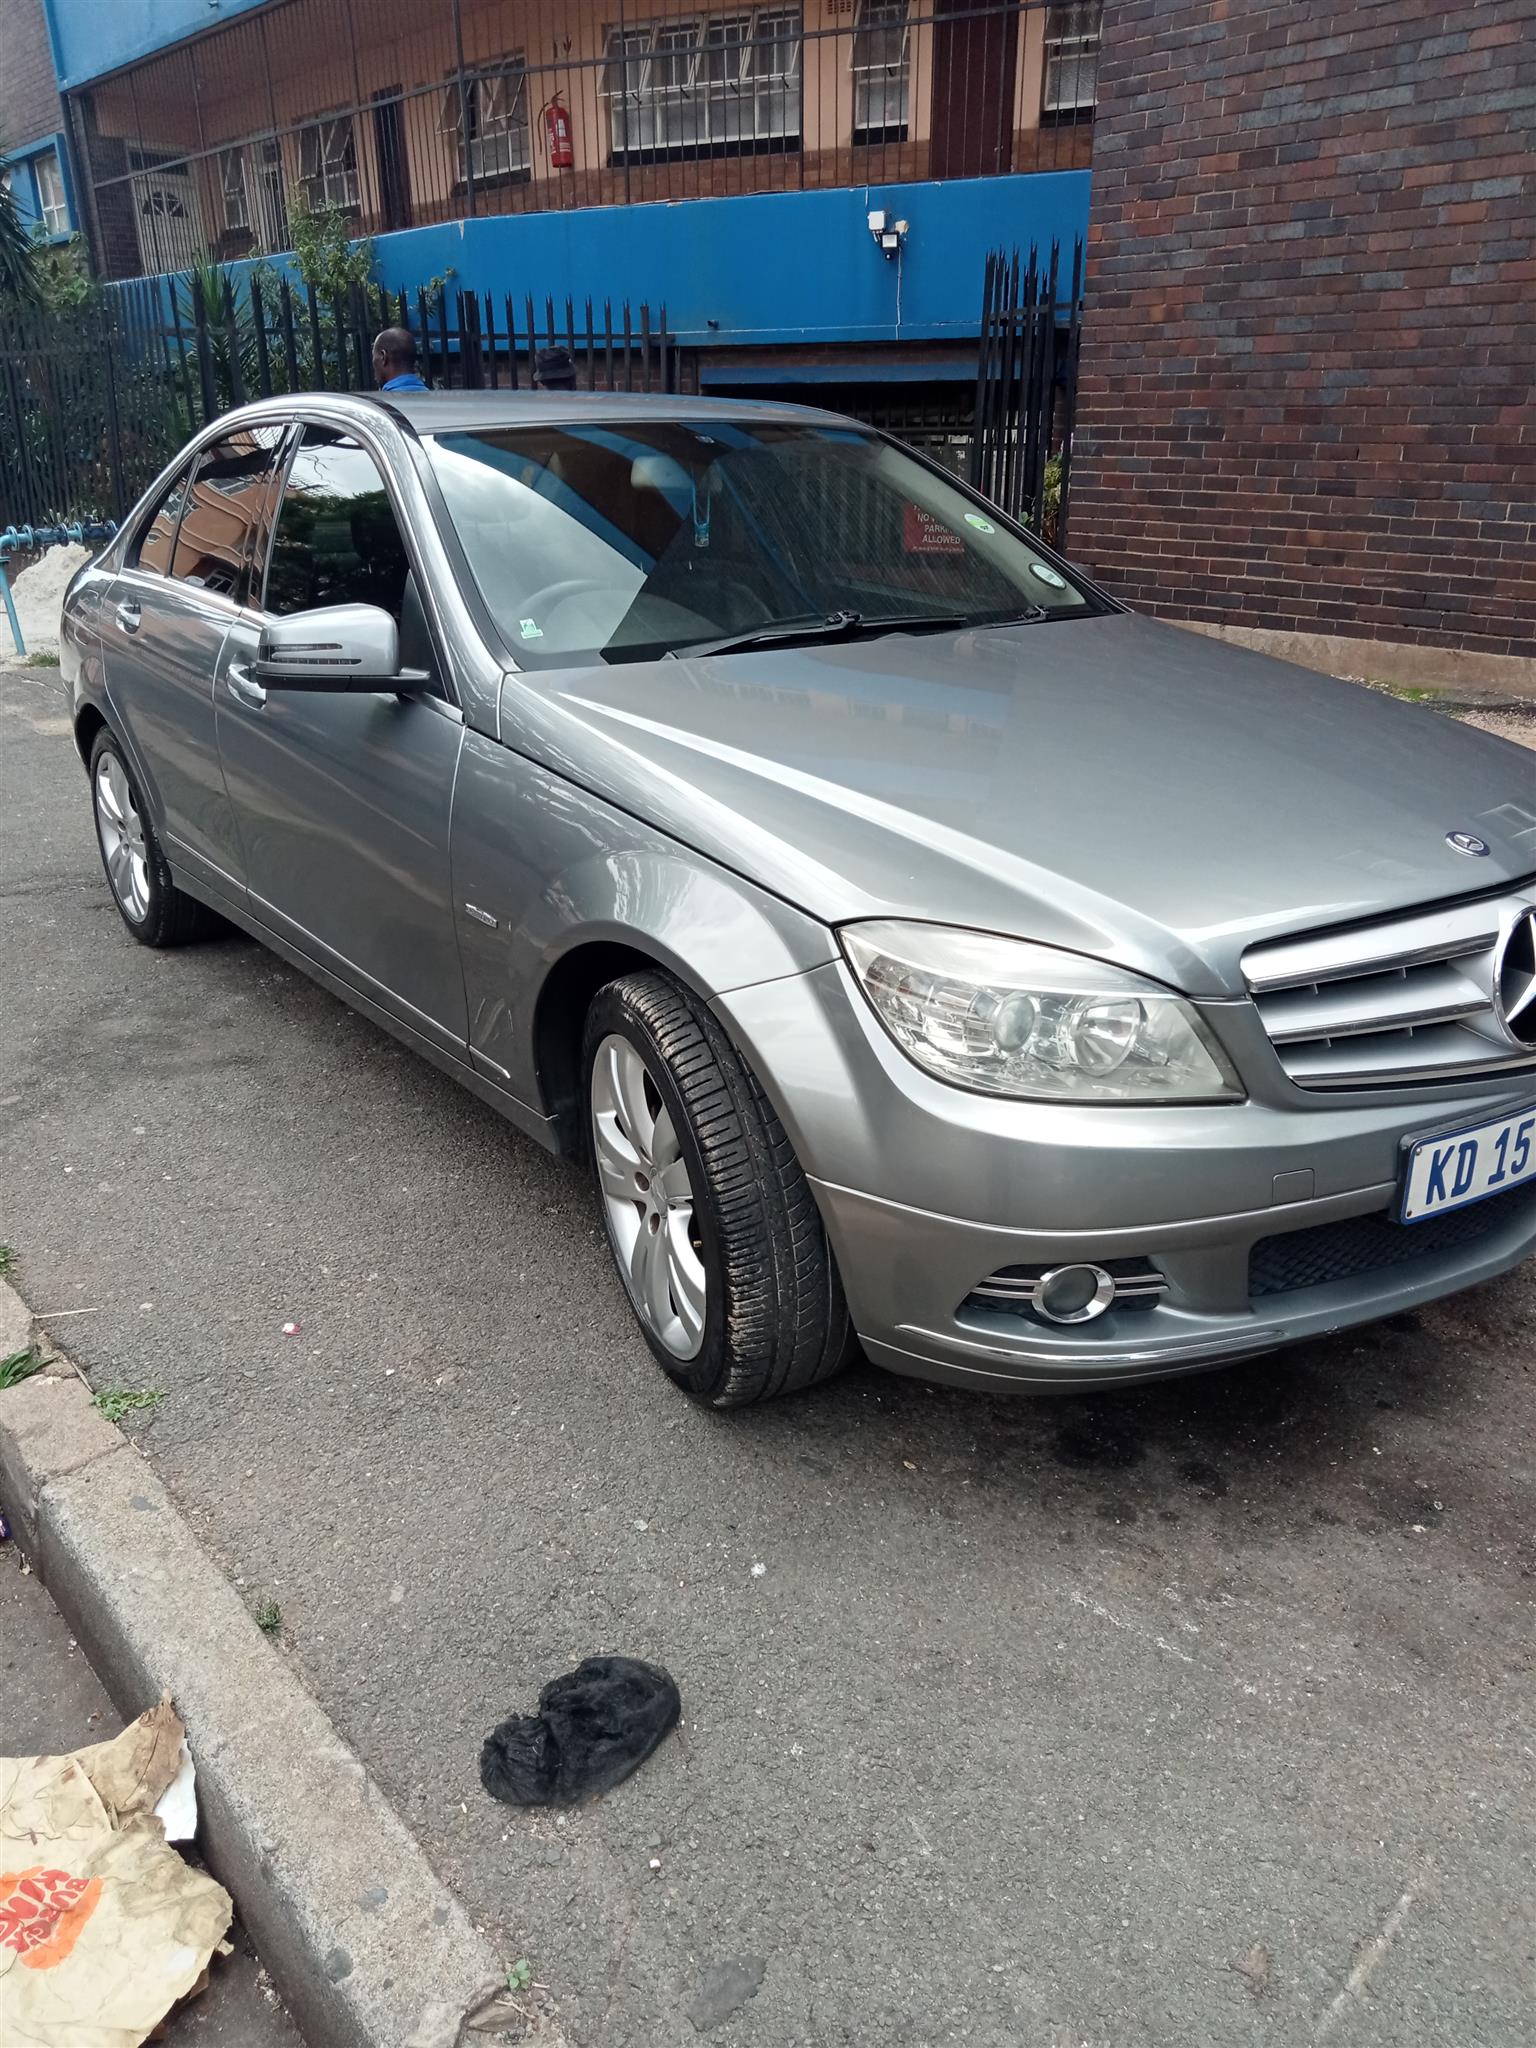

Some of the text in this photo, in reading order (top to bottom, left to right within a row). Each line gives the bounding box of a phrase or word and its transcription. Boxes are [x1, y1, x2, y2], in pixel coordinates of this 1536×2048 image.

[917, 513, 930, 522] NO
[922, 534, 961, 545] ALLOWED
[1425, 1118, 1536, 1206] KD 15
